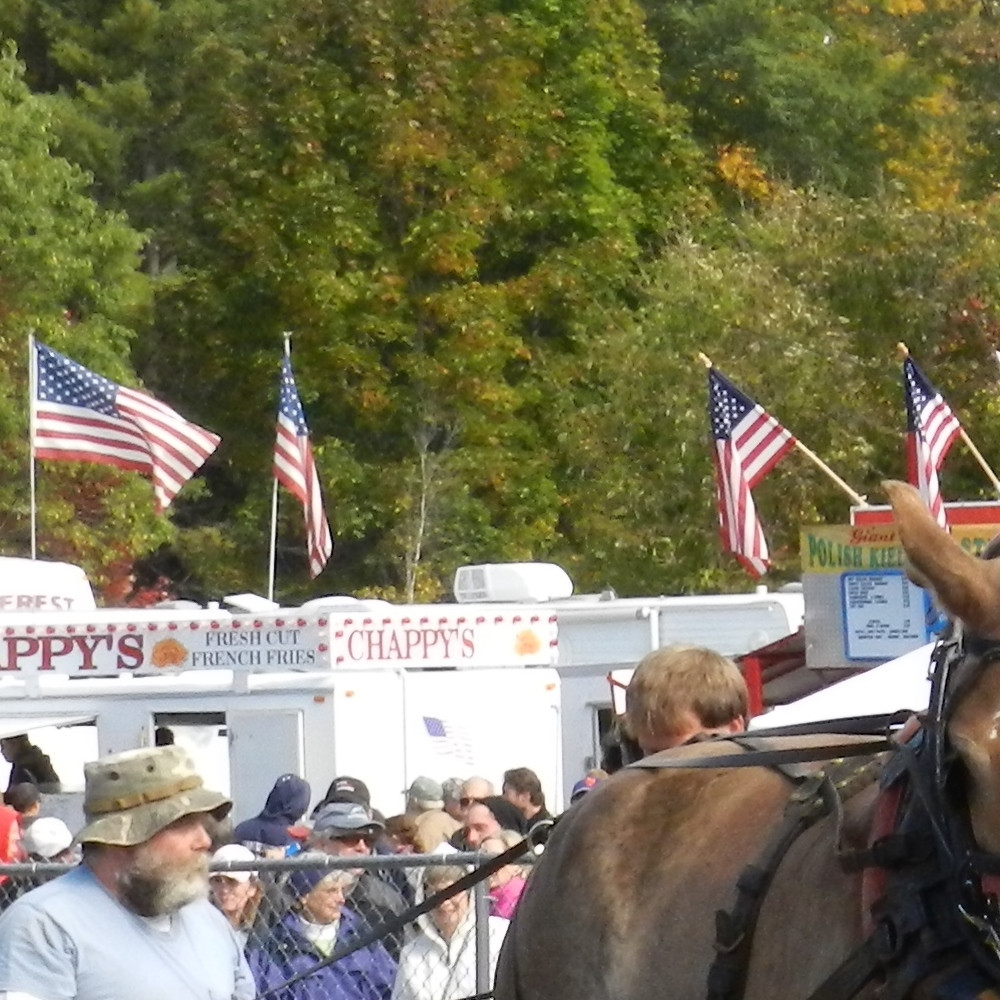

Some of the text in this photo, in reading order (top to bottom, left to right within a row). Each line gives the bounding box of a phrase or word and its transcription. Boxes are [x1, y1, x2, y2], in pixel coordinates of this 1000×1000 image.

[206, 629, 300, 646] FRESH CUT
[347, 628, 475, 661] CHAPPY'S
[0, 634, 144, 671] PPY'S
[192, 649, 315, 667] FRENCH FRIES
